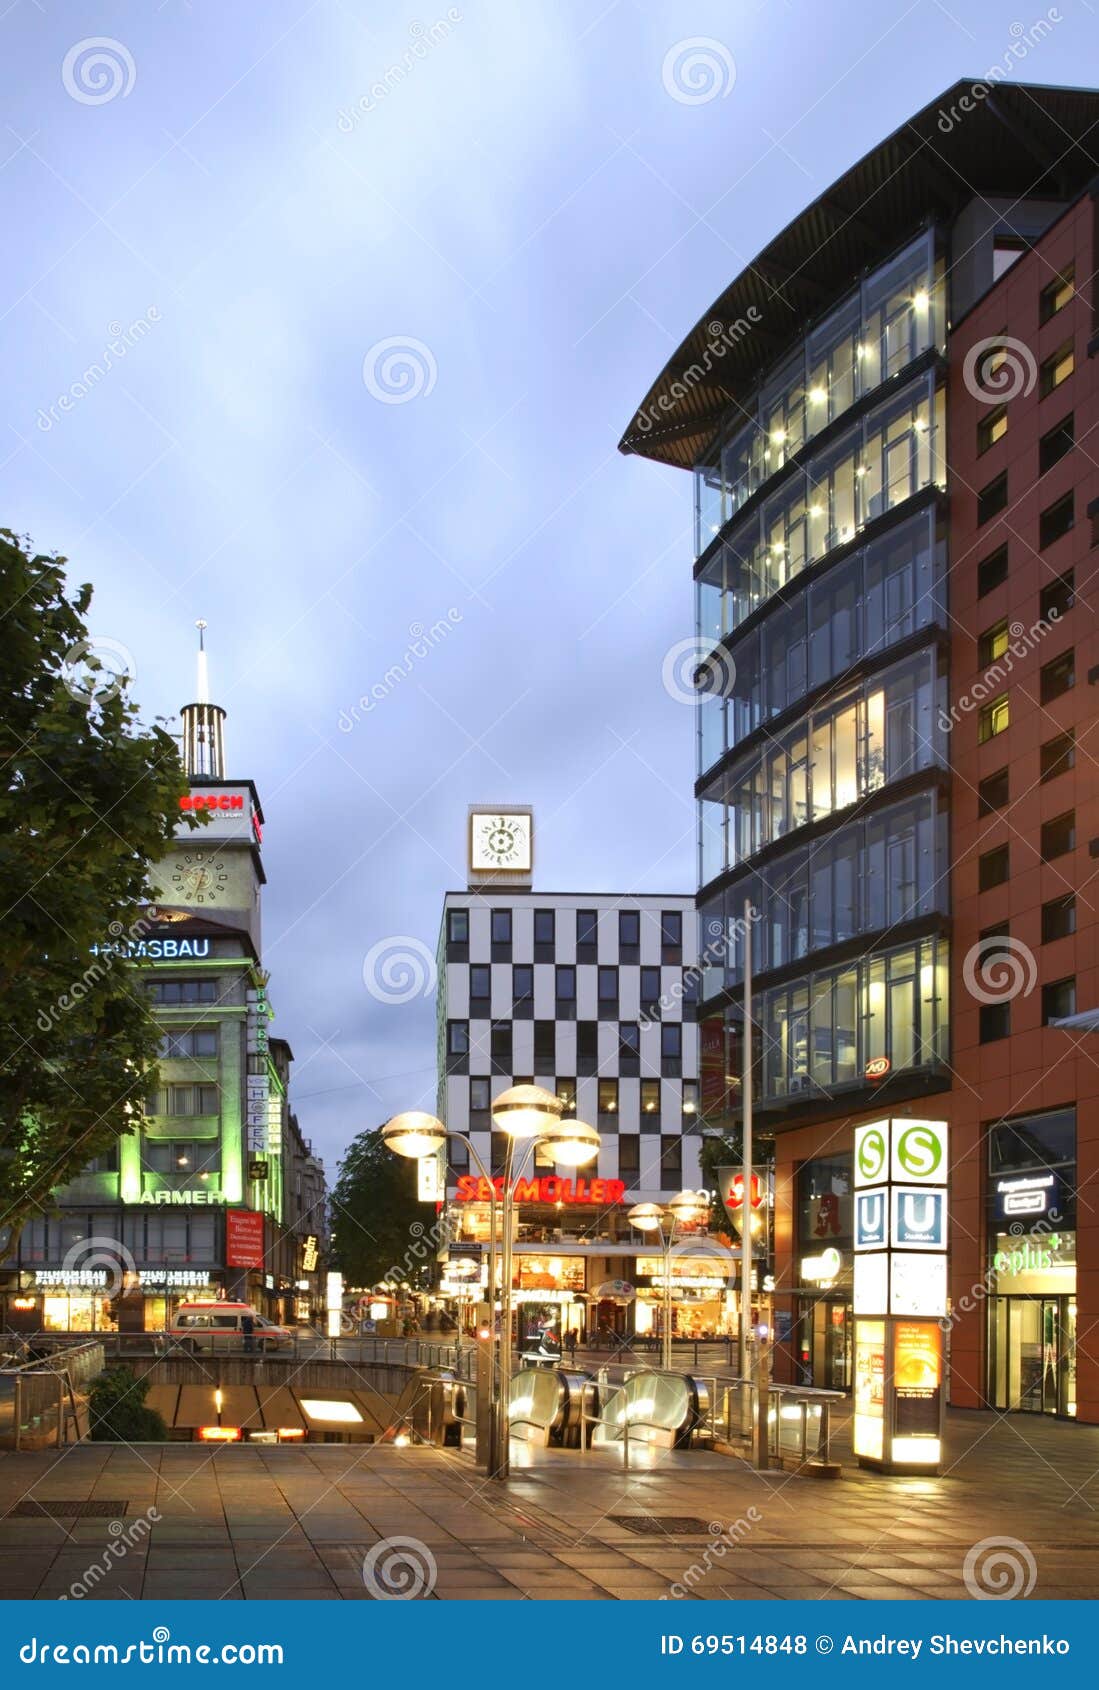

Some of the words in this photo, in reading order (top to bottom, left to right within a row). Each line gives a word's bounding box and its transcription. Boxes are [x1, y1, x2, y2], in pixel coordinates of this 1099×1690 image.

[179, 795, 243, 810] BOSCH
[861, 1133, 882, 1176] S
[903, 1129, 936, 1175] S
[861, 1195, 881, 1233] U
[903, 1194, 936, 1233] U
